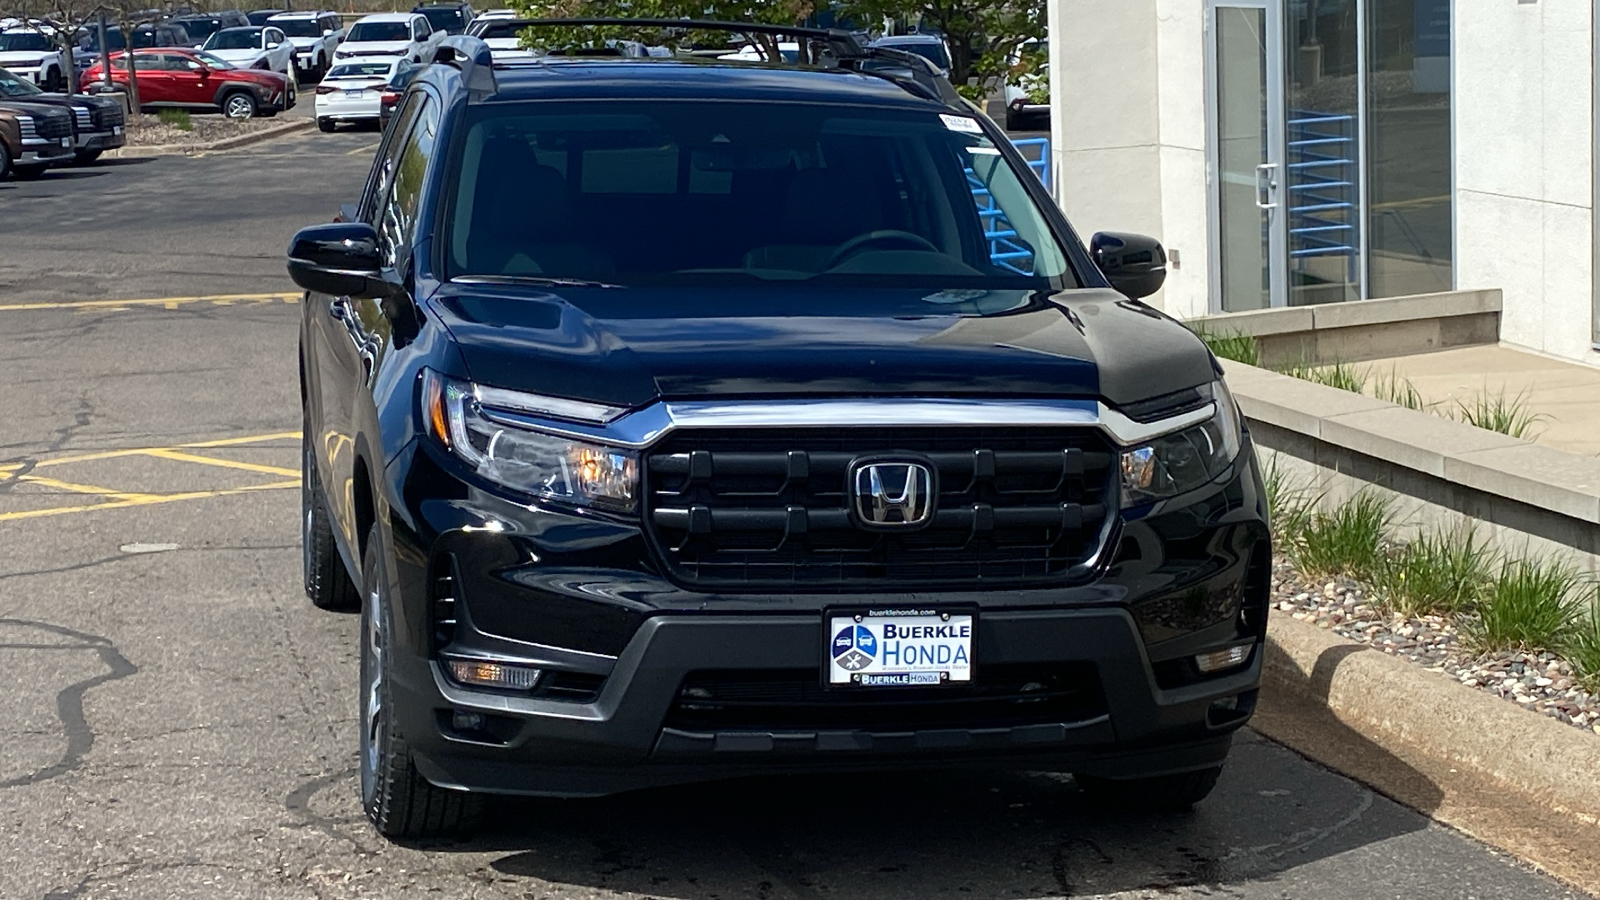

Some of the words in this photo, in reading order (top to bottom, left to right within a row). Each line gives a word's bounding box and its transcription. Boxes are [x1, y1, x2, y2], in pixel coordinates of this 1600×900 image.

[869, 609, 936, 617] buerklehonda.com
[883, 624, 970, 639] BUERKLE
[882, 640, 968, 665] HONDA
[861, 674, 909, 684] BUERKLE
[911, 674, 939, 684] HONDA
